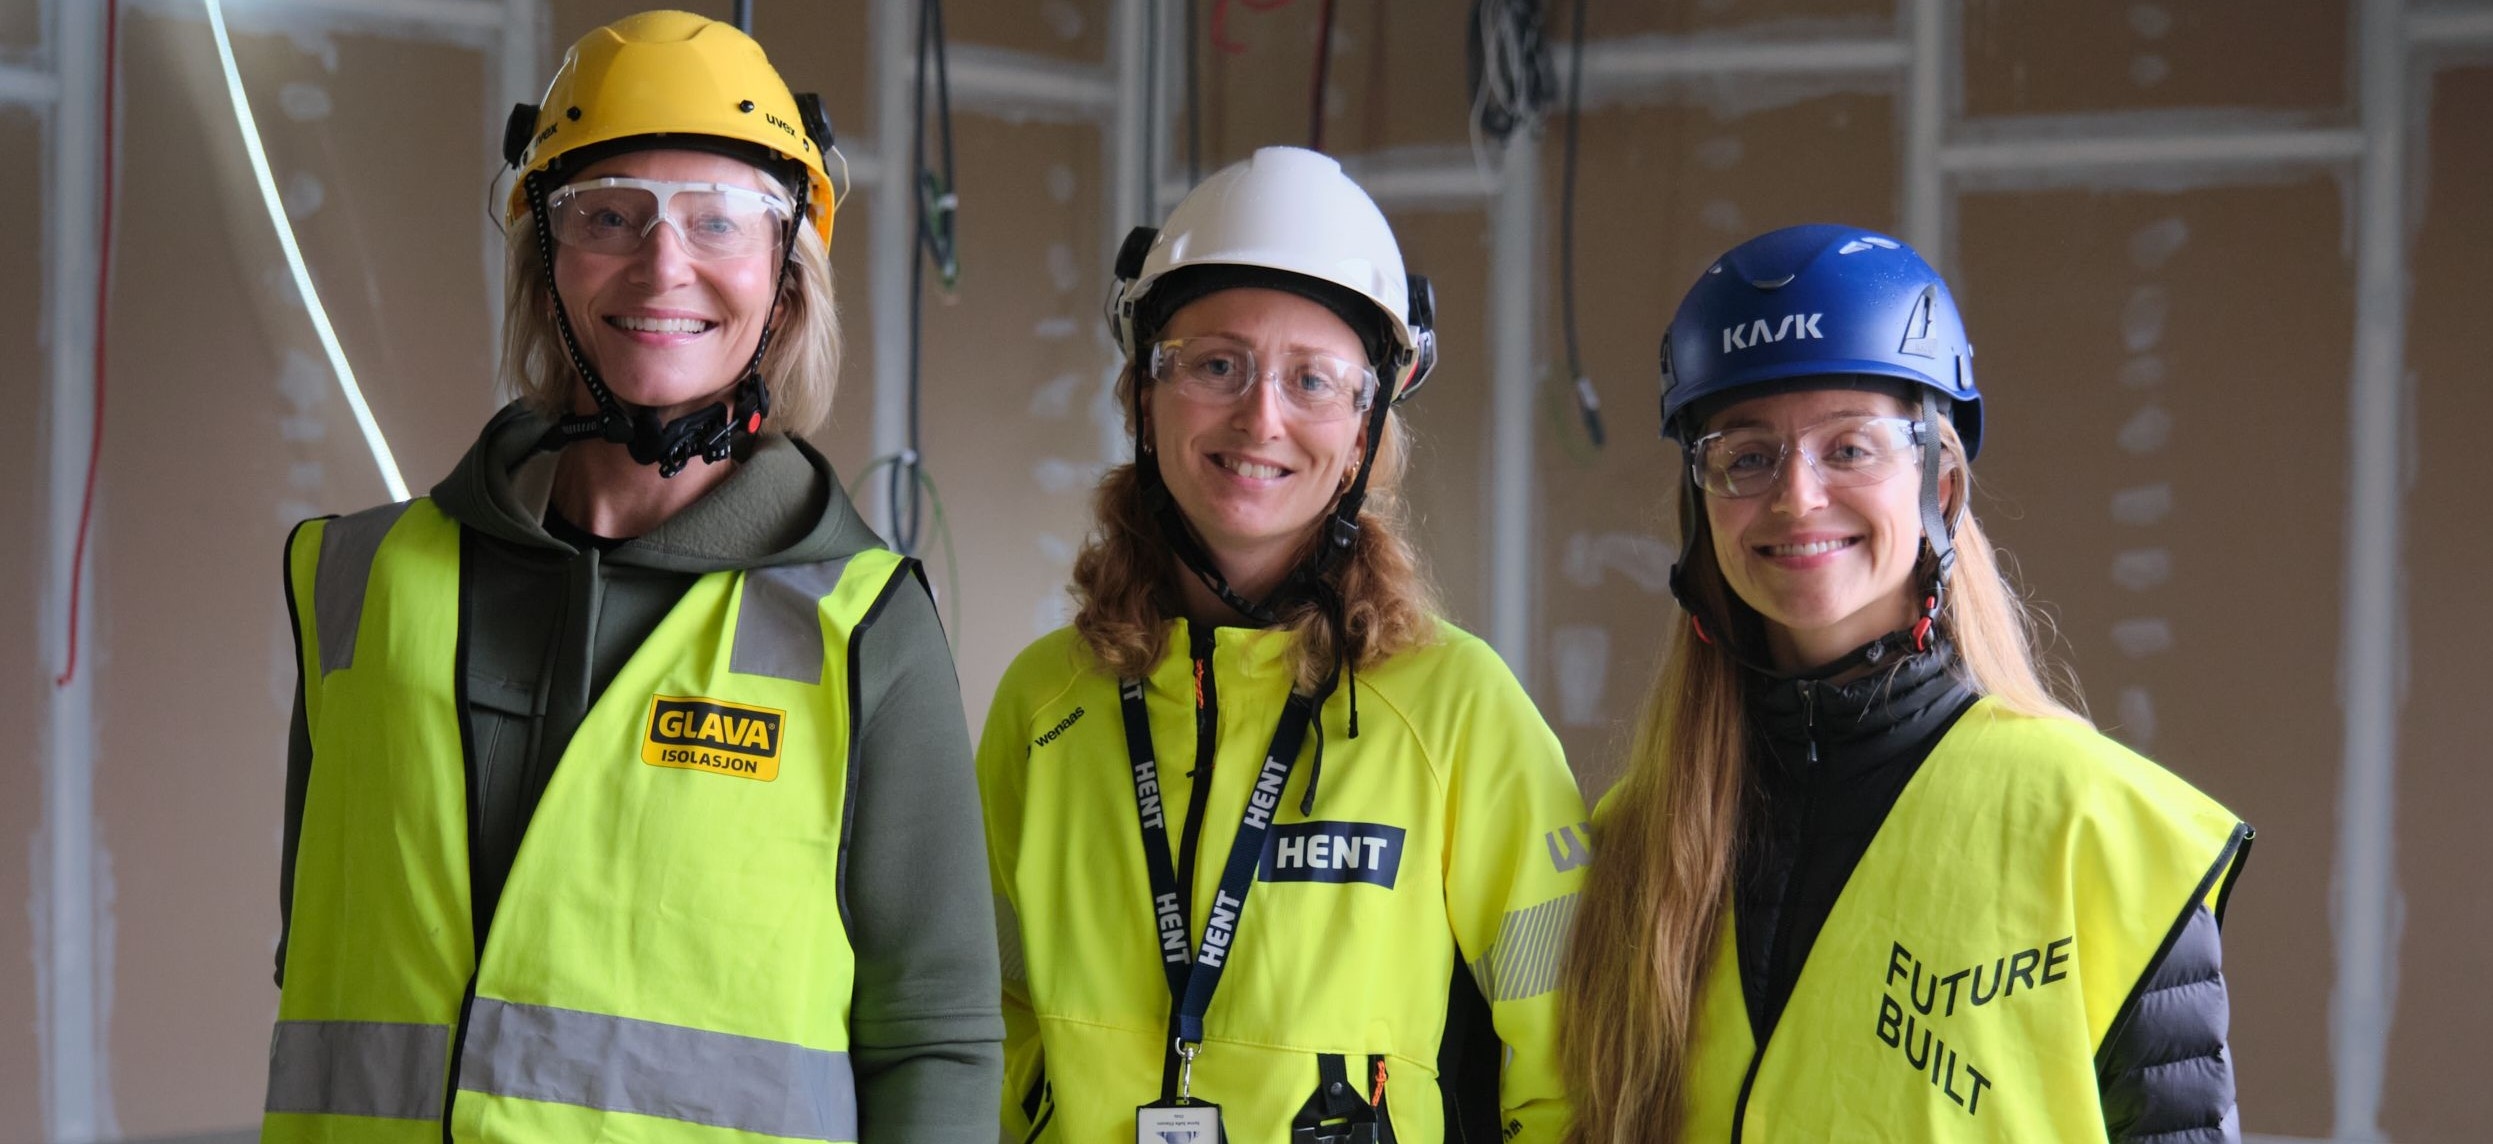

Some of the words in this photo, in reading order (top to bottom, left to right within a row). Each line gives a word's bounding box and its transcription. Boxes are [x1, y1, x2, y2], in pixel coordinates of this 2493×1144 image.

[766, 113, 796, 138] uvex
[1723, 313, 1824, 354] KASK
[661, 749, 758, 773] ISOLASJON
[1035, 706, 1085, 747] wenaas
[1135, 760, 1163, 829] HENT
[1243, 755, 1288, 830] HENT
[1276, 834, 1388, 871] HENT
[1156, 892, 1191, 965] HENT
[1198, 889, 1241, 968] HENT
[1886, 935, 2073, 1017] FUTURE
[1876, 992, 1991, 1116] BUILT
